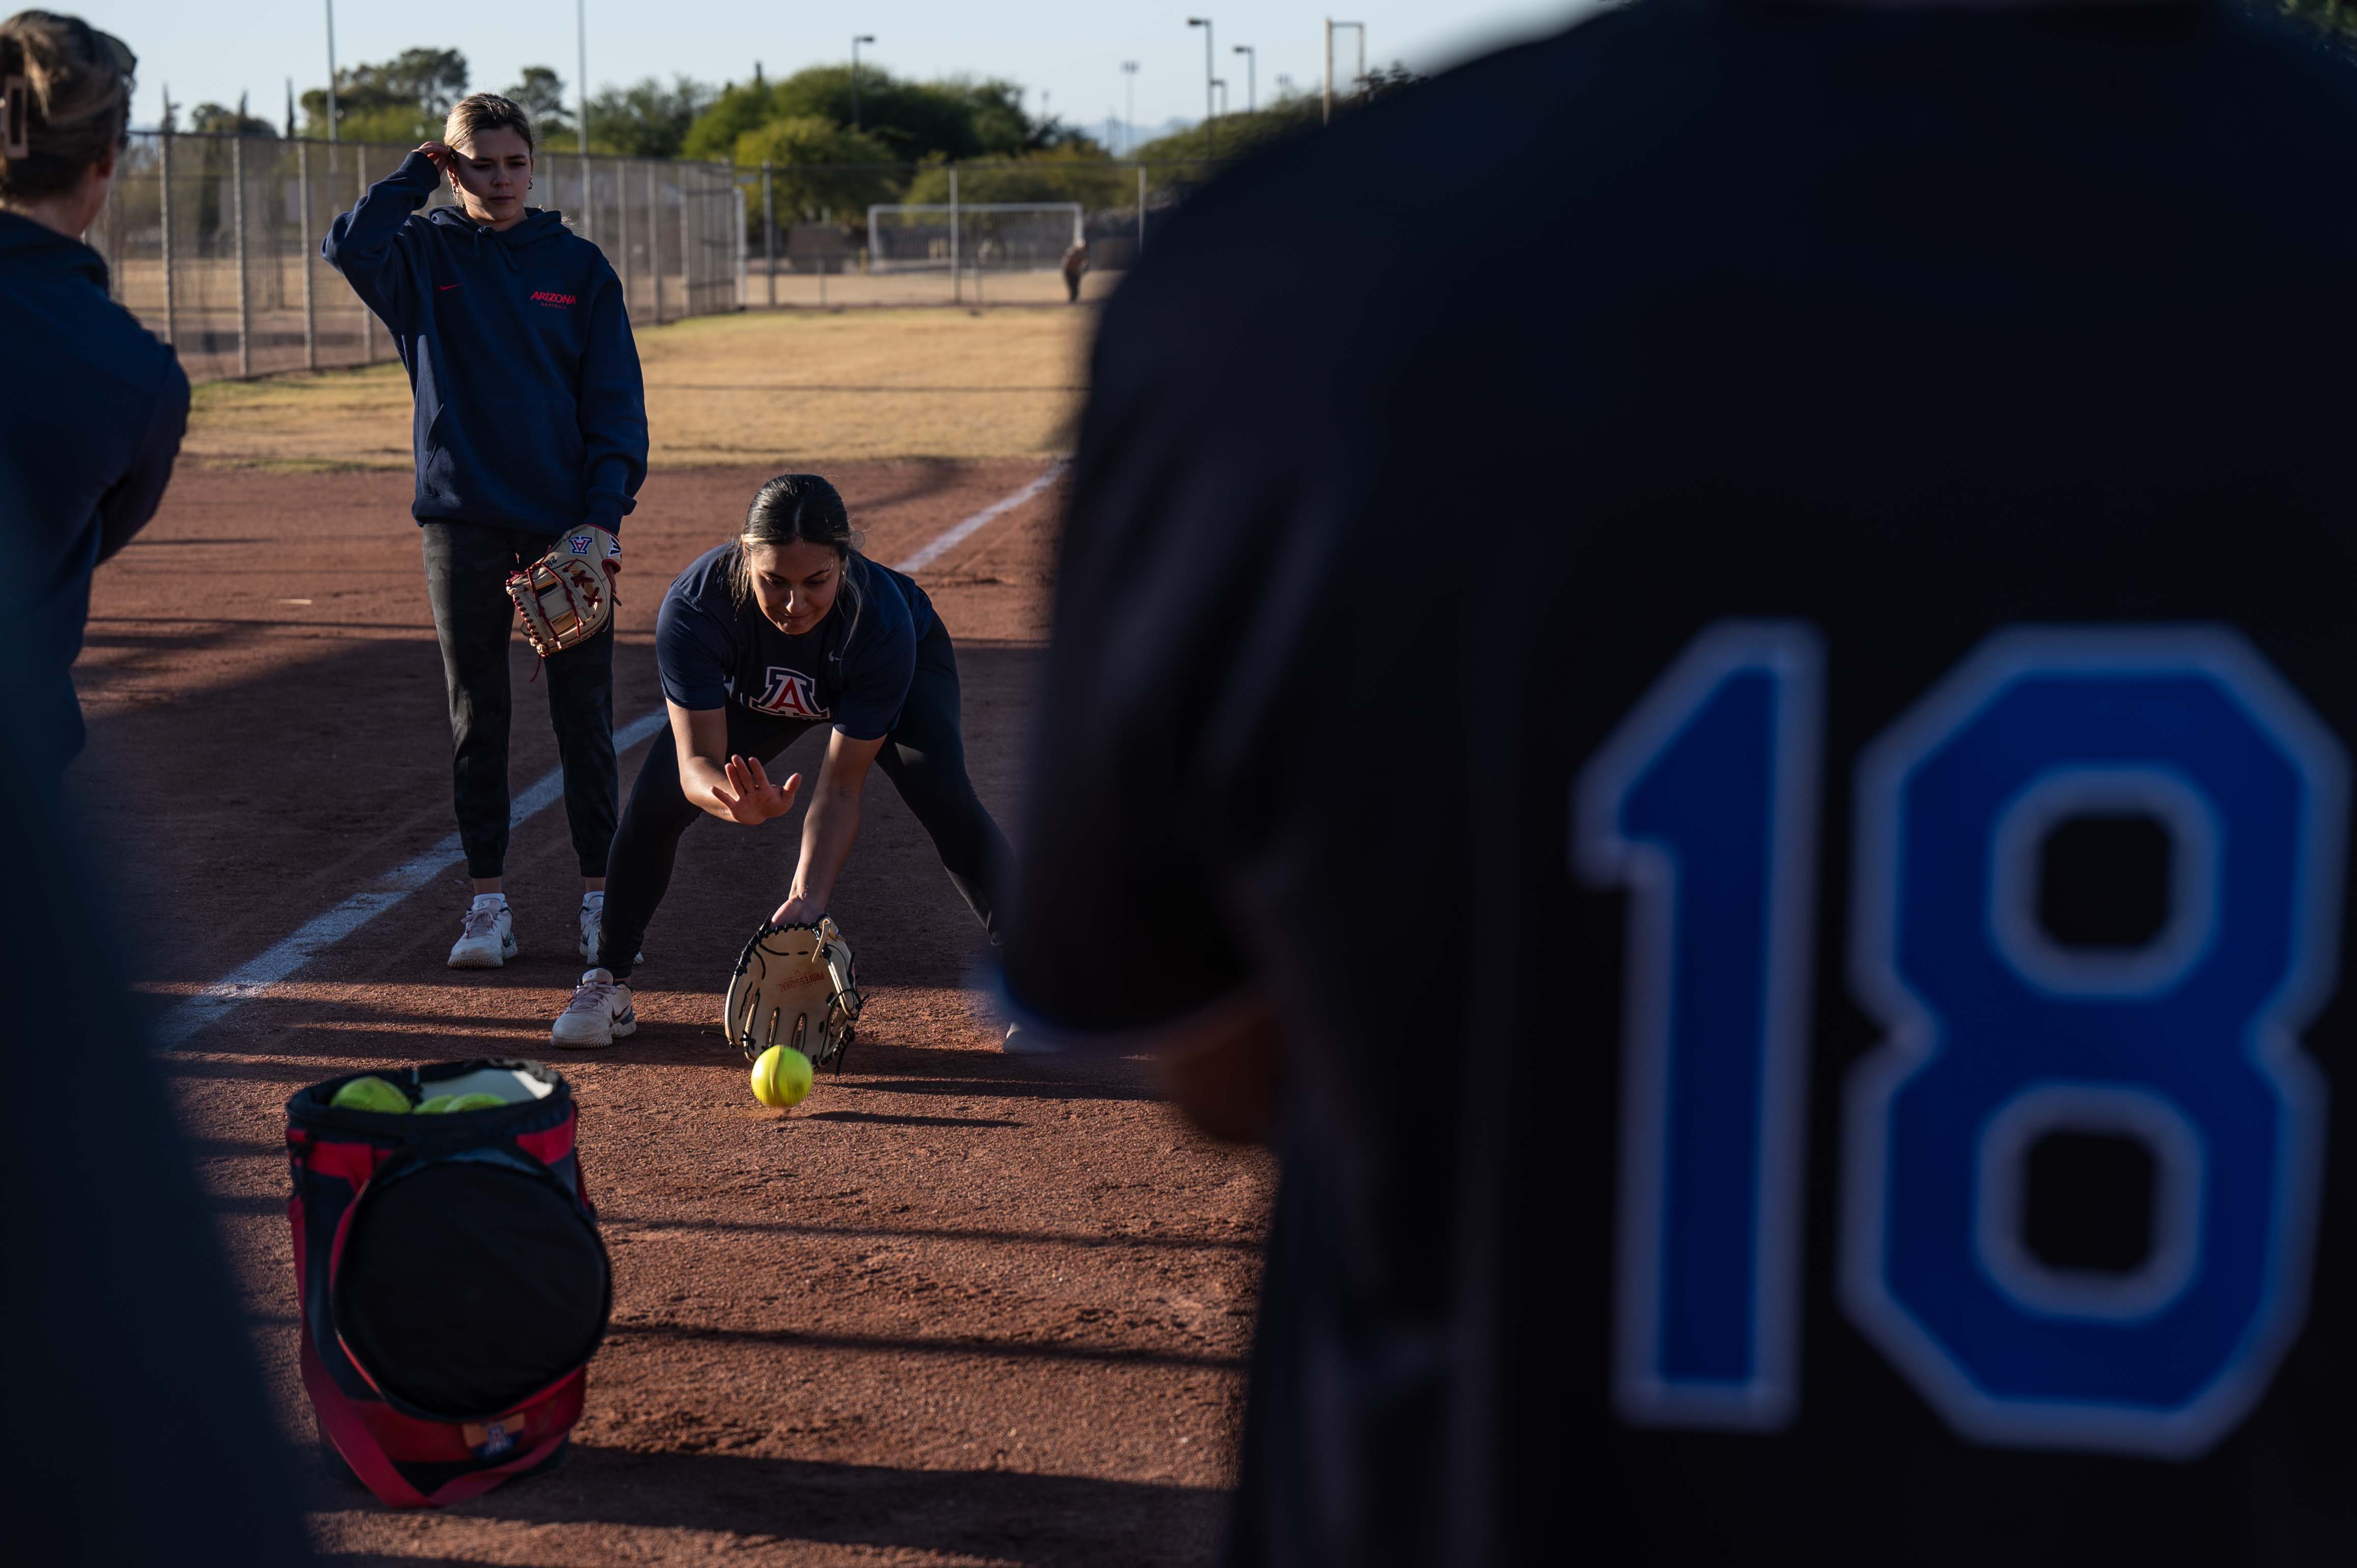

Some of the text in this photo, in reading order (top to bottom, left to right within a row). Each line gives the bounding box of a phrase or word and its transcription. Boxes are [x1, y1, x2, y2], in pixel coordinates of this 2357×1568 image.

[530, 291, 577, 304] ARIZONA
[568, 535, 594, 556] A
[749, 666, 831, 720] A
[777, 971, 825, 993] PROFESSIONAL
[1570, 617, 2353, 1461] 18
